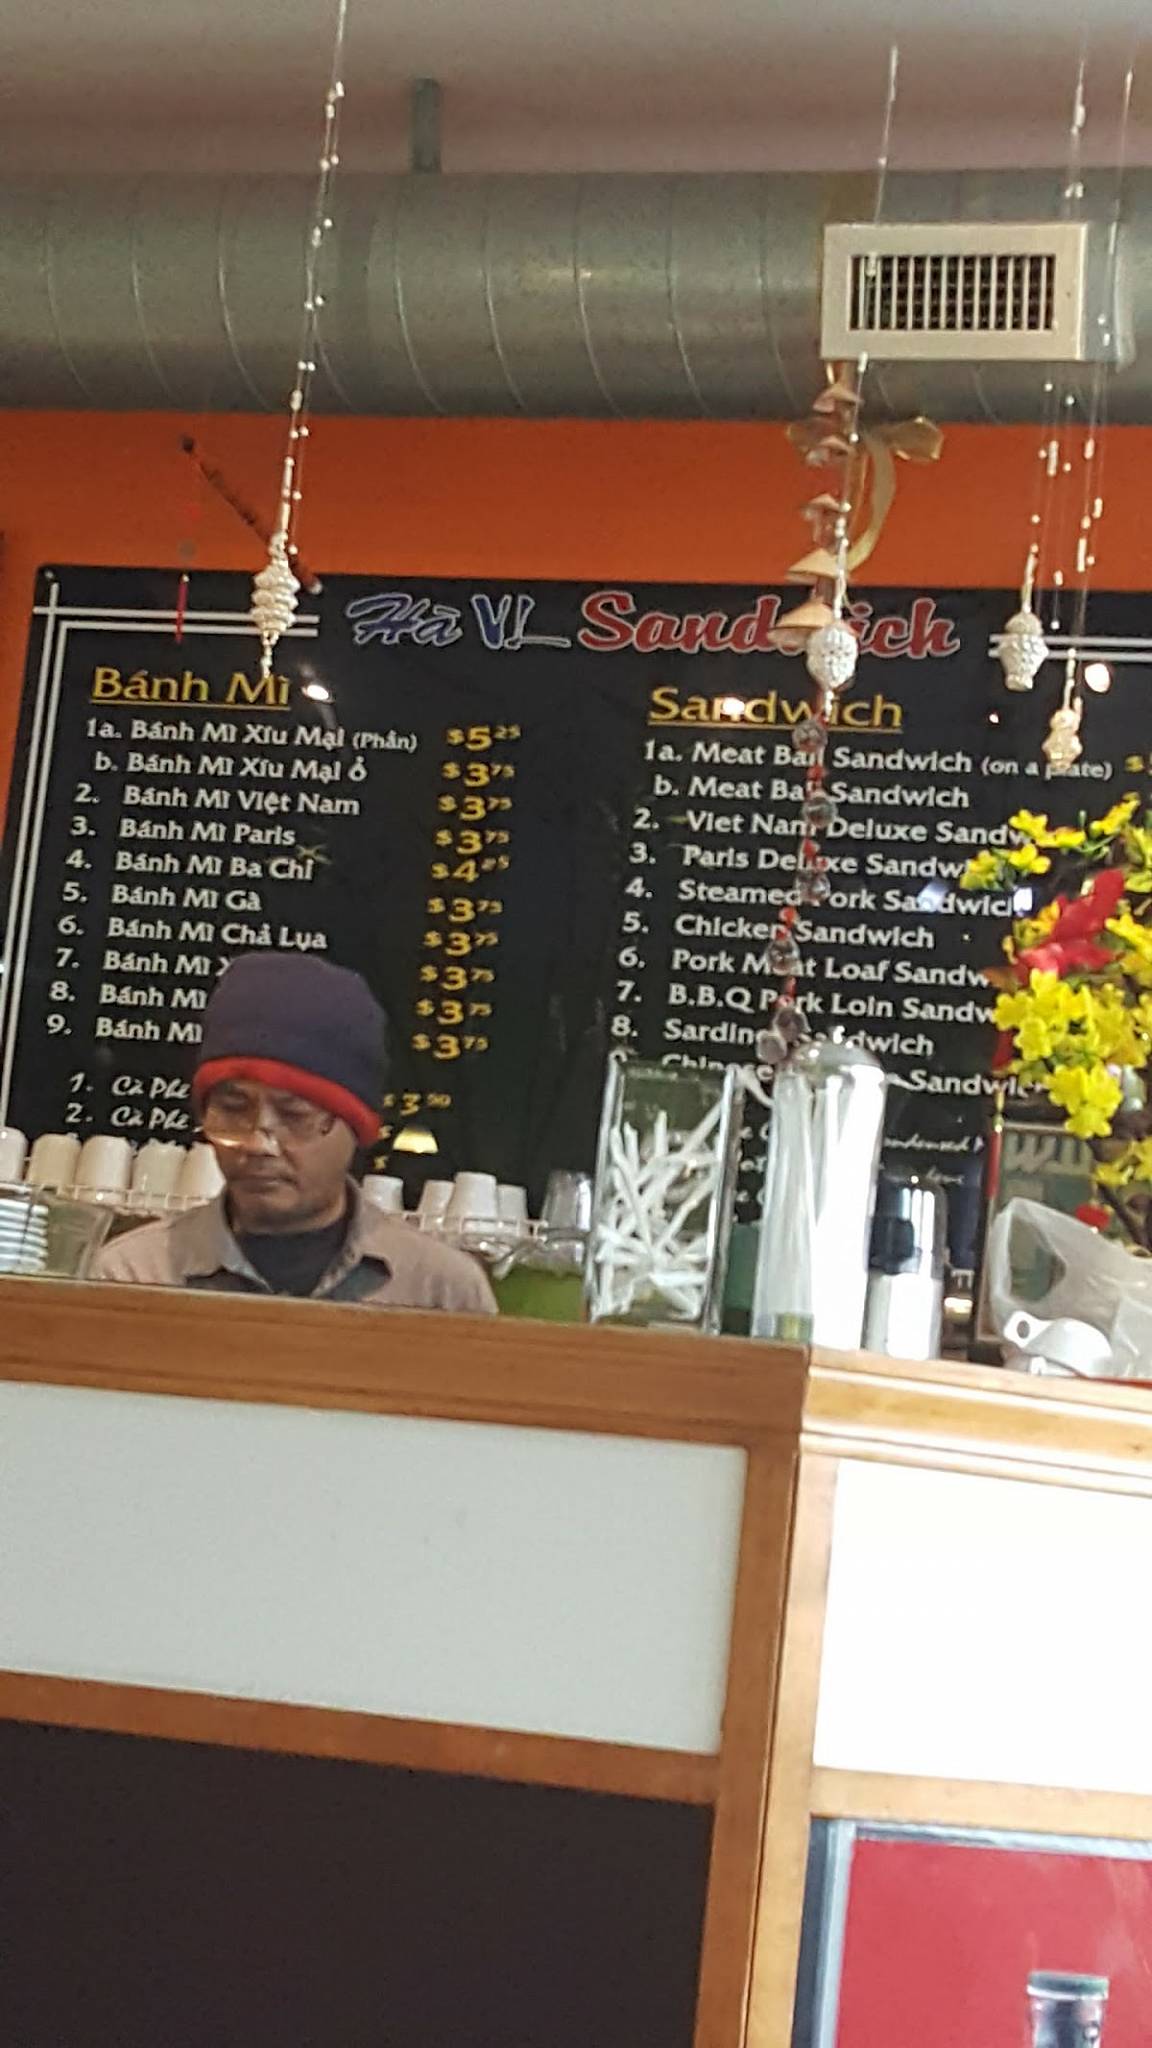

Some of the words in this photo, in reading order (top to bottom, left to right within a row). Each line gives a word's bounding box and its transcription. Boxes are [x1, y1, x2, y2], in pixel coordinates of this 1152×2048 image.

[578, 588, 960, 659] Sandich
[92, 666, 209, 702] Bánh
[86, 718, 122, 739] 1a.
[131, 719, 194, 742] Bánh
[95, 751, 118, 771] b.
[127, 752, 191, 774] Bánh
[644, 739, 682, 762] 1a.
[691, 741, 766, 765] Meat
[832, 746, 972, 773] Sandwich
[981, 756, 1020, 776] (on
[1024, 761, 1039, 776] a
[1045, 758, 1113, 781] pate)
[75, 783, 99, 803] 2.
[123, 784, 187, 808] Bánh
[297, 793, 360, 815] Nam
[653, 775, 679, 796] b.
[688, 776, 763, 800] Meat
[831, 781, 969, 808] Sandwich
[70, 816, 96, 836] 3.
[119, 818, 184, 841] Bánh
[232, 823, 296, 846] Paris
[632, 808, 659, 830] 2.
[686, 810, 744, 833] Viet
[826, 816, 928, 842] Deluxe
[935, 820, 1030, 845] Sandw
[65, 849, 92, 869] 4.
[115, 851, 180, 874] Bánh
[229, 856, 263, 878] Ba
[629, 842, 656, 864] 3.
[683, 844, 750, 868] Paris
[865, 853, 972, 879] Sandw
[62, 882, 88, 902] 5.
[111, 884, 175, 907] Bánh
[225, 889, 261, 911] Gà
[626, 877, 652, 898] 4.
[808, 886, 876, 910] ork
[57, 915, 84, 935] 6.
[107, 917, 171, 940] Bánh
[622, 911, 648, 933] 5.
[795, 920, 934, 949] Sandwich
[56, 948, 80, 968] 7.
[103, 950, 168, 973] Bánh
[618, 947, 645, 968] 6.
[672, 949, 735, 973] Pork
[742, 952, 816, 977] Mat
[825, 957, 890, 982] Loaf
[895, 961, 990, 989] Sandw
[50, 981, 75, 1001] 8.
[100, 983, 164, 1007] Bánh
[616, 980, 641, 1002] 7.
[668, 983, 755, 1014] B.B.Q
[759, 988, 824, 1014] Prk
[832, 993, 893, 1018] Loin
[902, 998, 996, 1024] Sandw
[47, 1014, 72, 1035] 9.
[96, 1017, 160, 1040] Bánh
[611, 1015, 638, 1037] 8.
[663, 1018, 762, 1045] Sardin
[815, 1029, 934, 1057] dwich
[70, 1072, 94, 1093] 1.
[911, 1069, 1044, 1098] Sandwi
[65, 1103, 93, 1123] 2.
